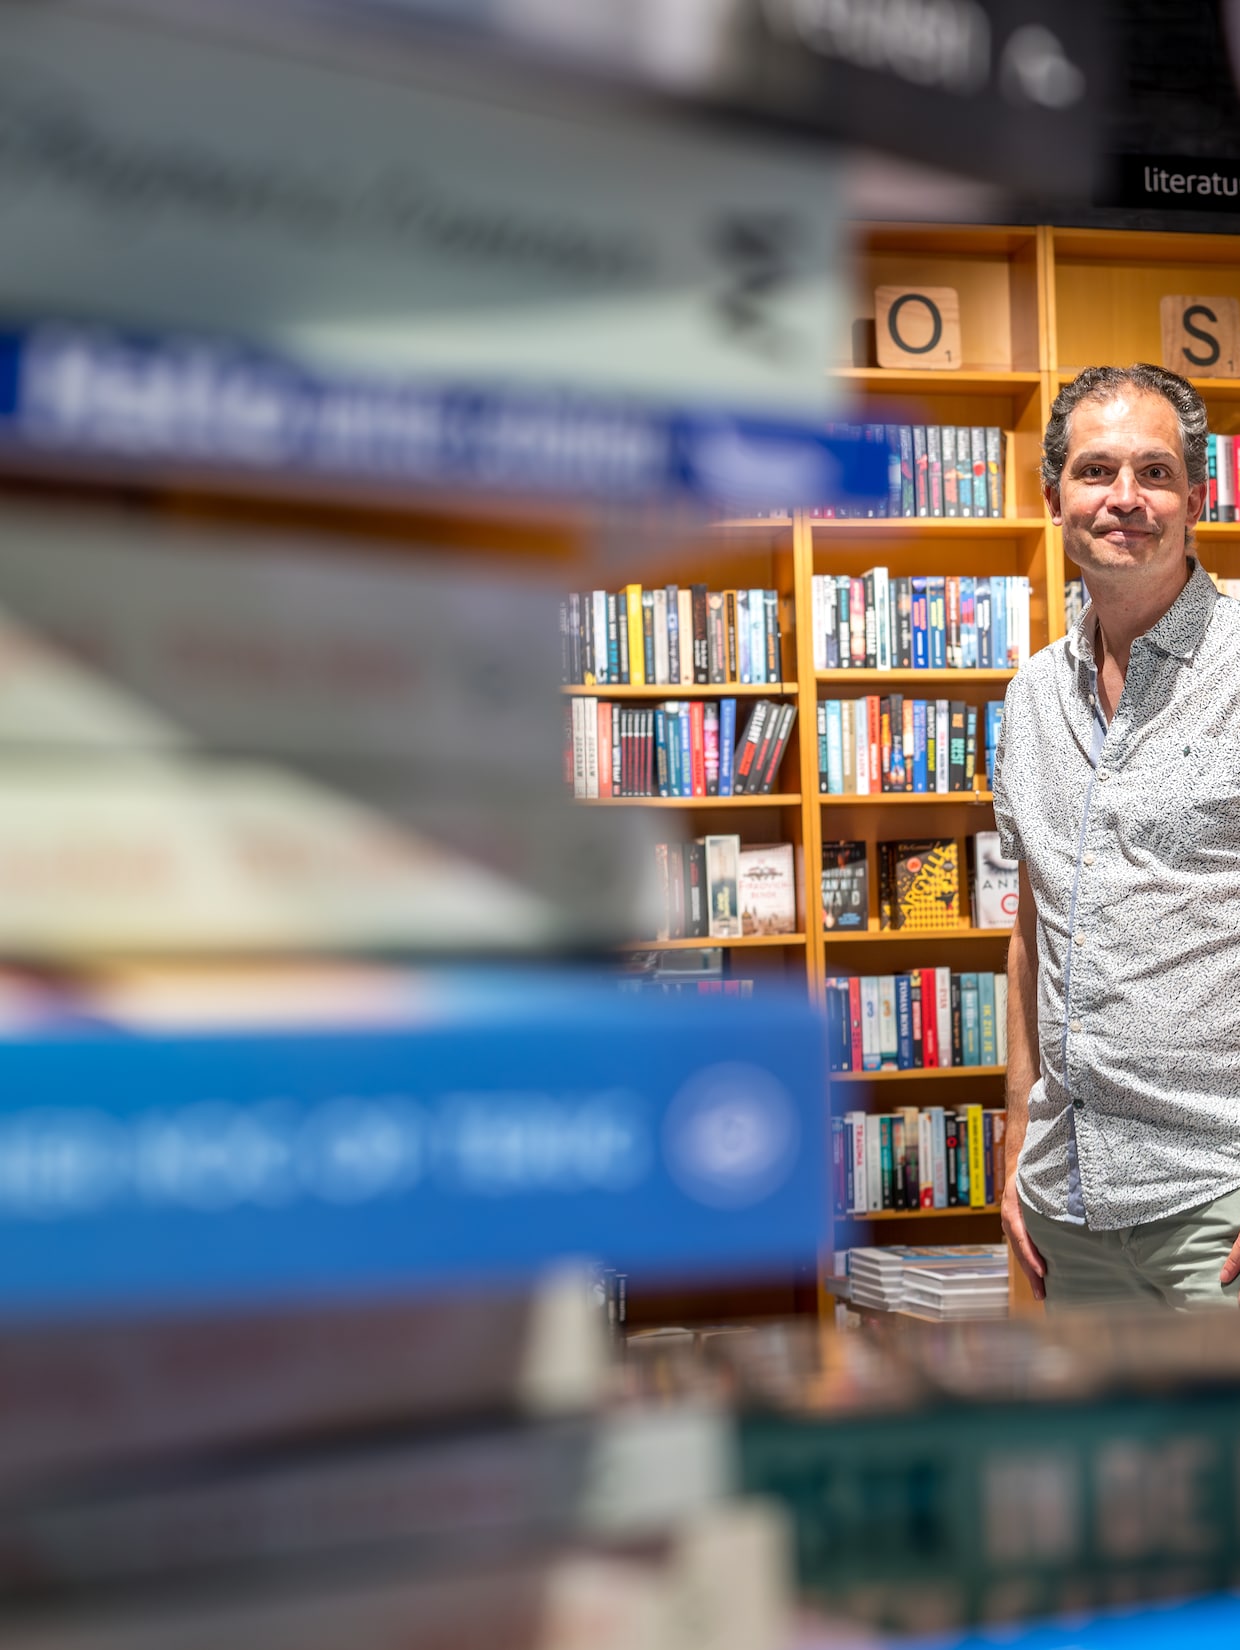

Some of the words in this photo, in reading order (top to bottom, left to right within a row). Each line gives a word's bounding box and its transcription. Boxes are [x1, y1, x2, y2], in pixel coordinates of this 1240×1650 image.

[887, 292, 943, 355] O
[1182, 304, 1220, 367] S
[944, 349, 952, 364] 1
[898, 980, 909, 1013] TOMAS
[899, 1014, 909, 1037] ROSS
[855, 1124, 864, 1167] TRAUMA
